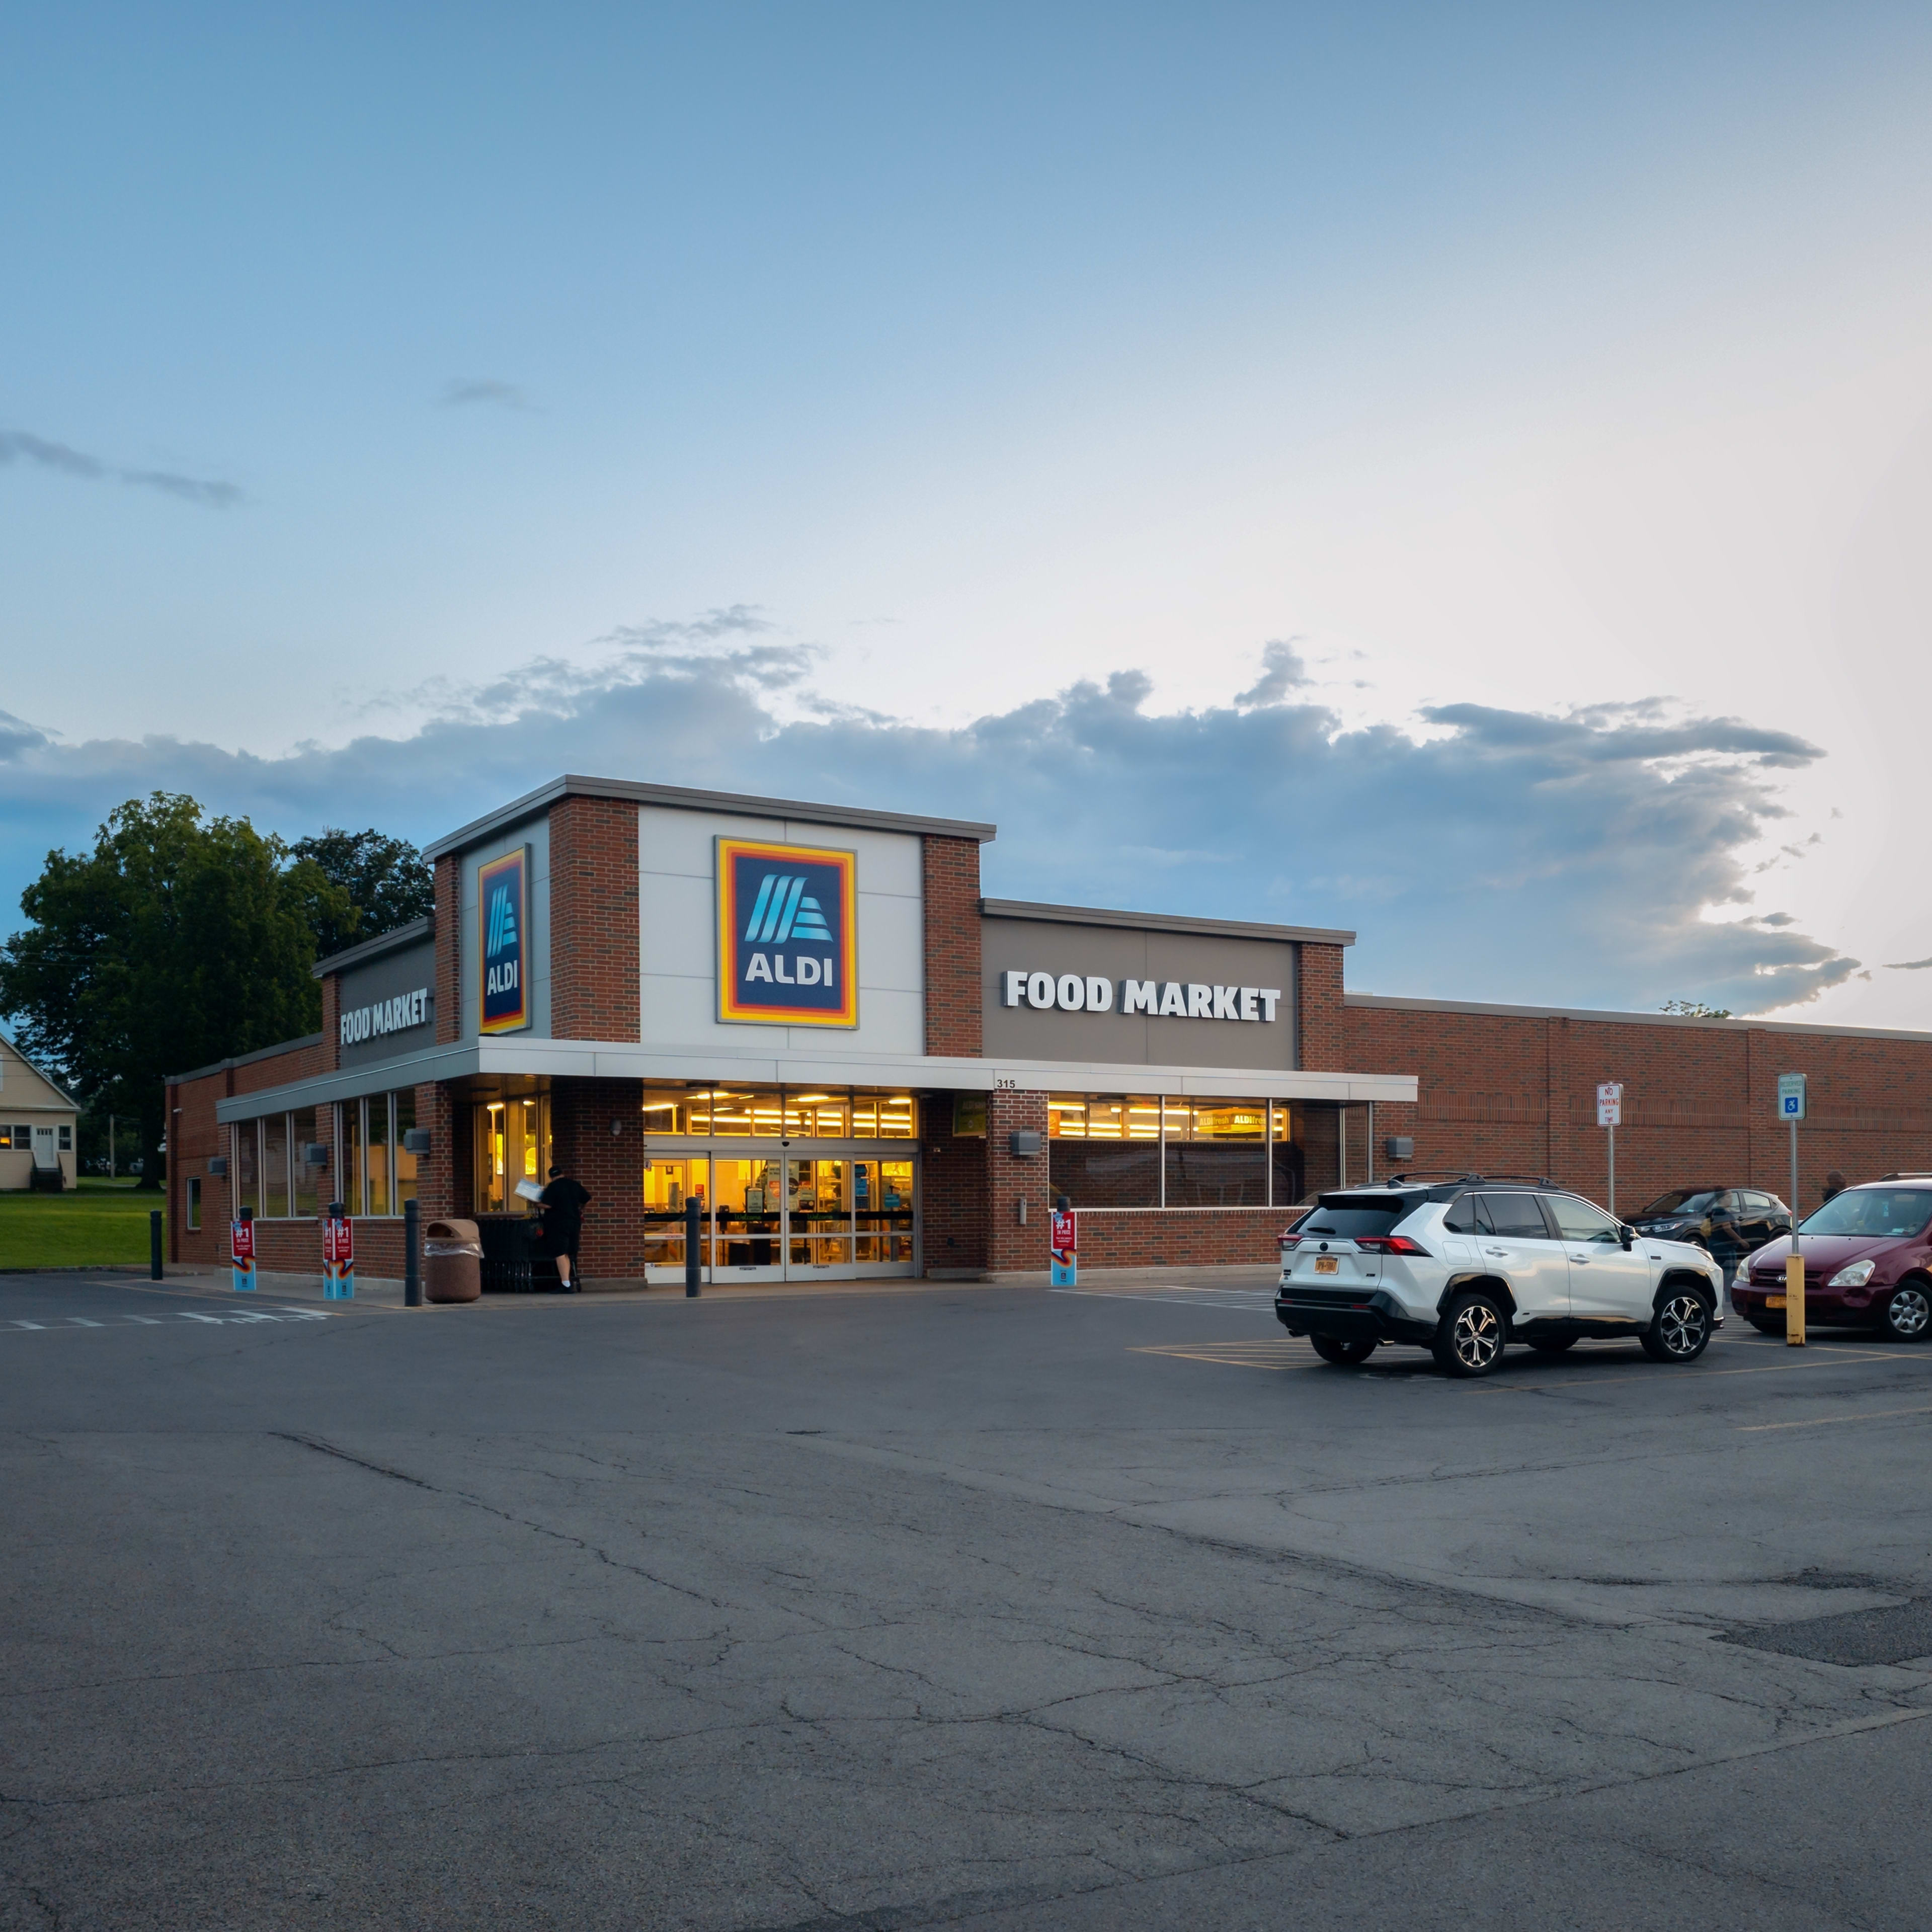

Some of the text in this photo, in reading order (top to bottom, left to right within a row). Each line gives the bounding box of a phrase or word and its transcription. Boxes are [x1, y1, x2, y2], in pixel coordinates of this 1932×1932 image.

[745, 953, 832, 986] ALDI
[487, 959, 518, 996] ALDI
[1006, 971, 1280, 1021] FOOD MARKET
[341, 988, 427, 1045] FOOD MARKET
[997, 1079, 1015, 1088] 315
[1605, 1087, 1613, 1096] NO
[1599, 1098, 1619, 1106] PARKING
[1056, 1219, 1071, 1230] #1
[235, 1228, 249, 1238] #1
[337, 1227, 349, 1238] #1
